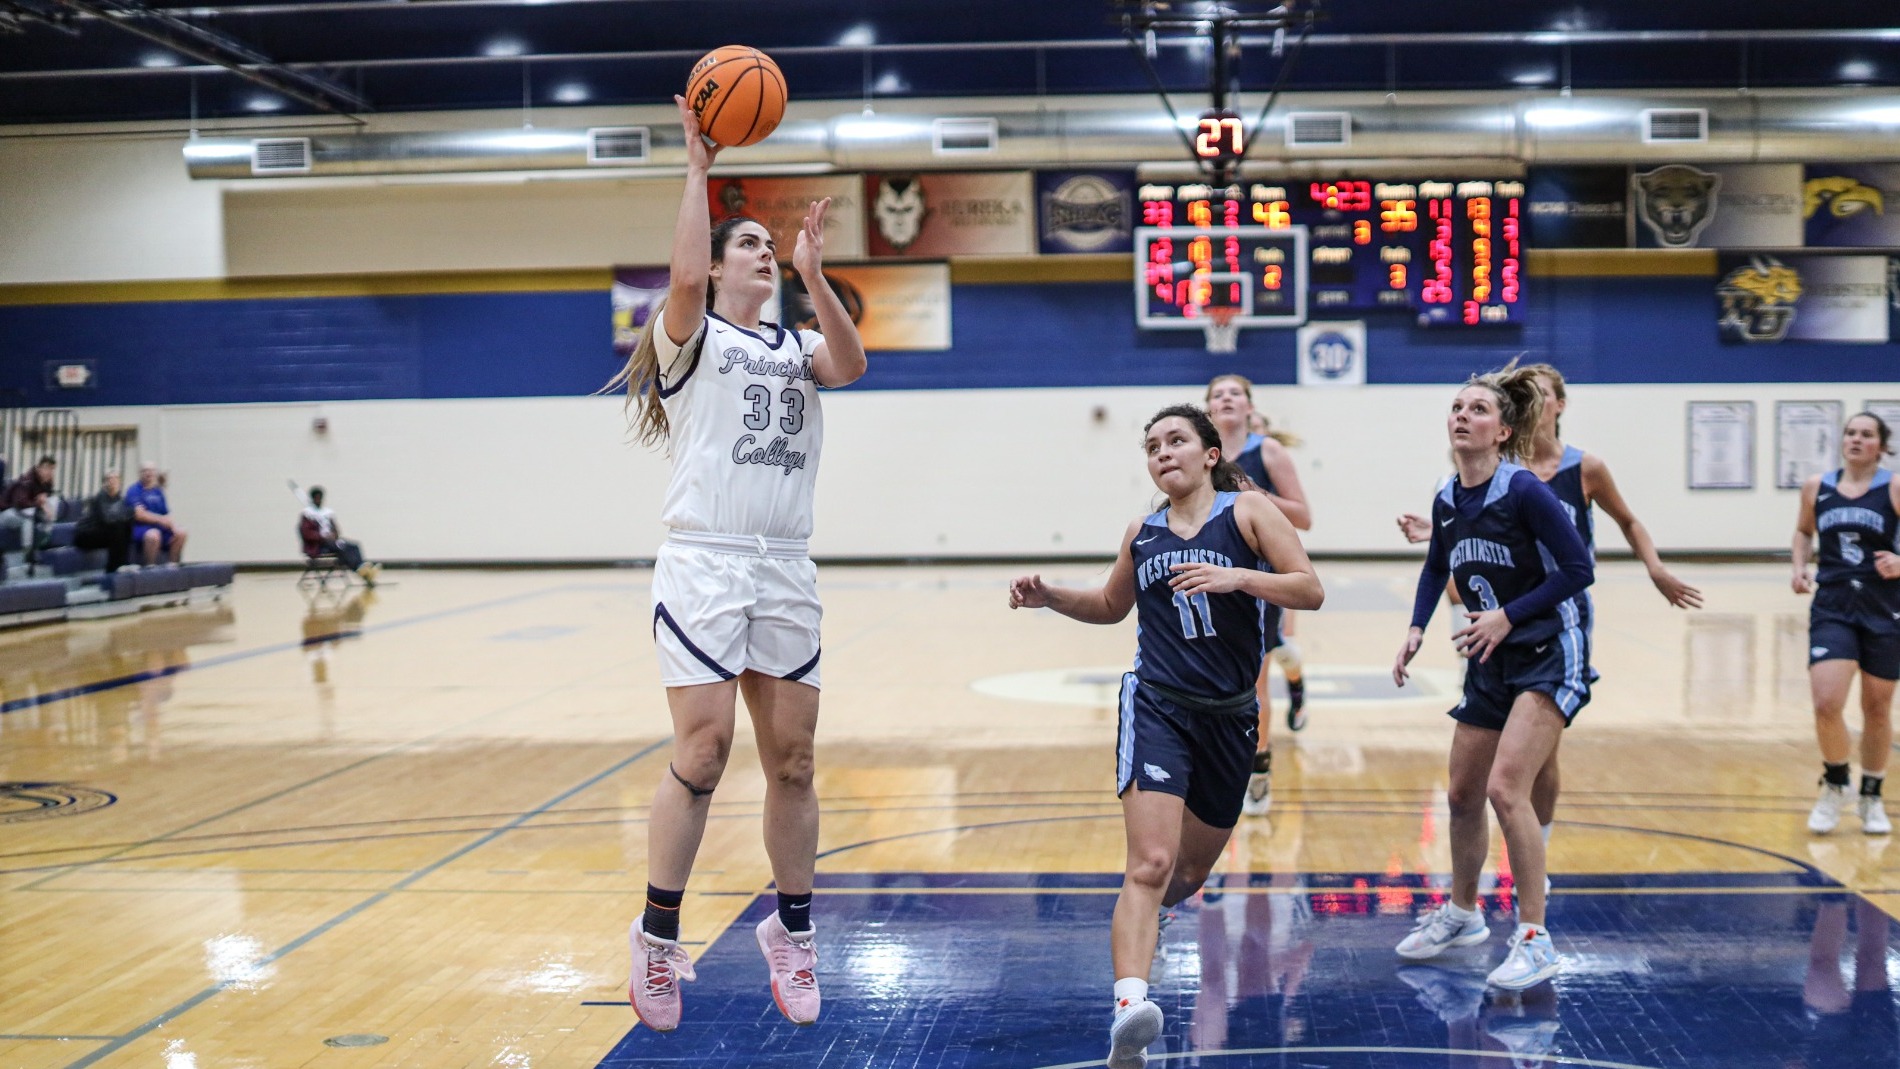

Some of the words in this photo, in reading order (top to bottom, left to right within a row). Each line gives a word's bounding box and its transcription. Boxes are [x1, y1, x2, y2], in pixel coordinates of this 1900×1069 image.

[1196, 117, 1243, 157] 27
[1353, 219, 1371, 246] 3
[1389, 263, 1407, 290] 3
[743, 384, 805, 435] 33
[1837, 531, 1865, 566] 5
[1468, 574, 1500, 611] 3
[1172, 589, 1217, 640] 11
